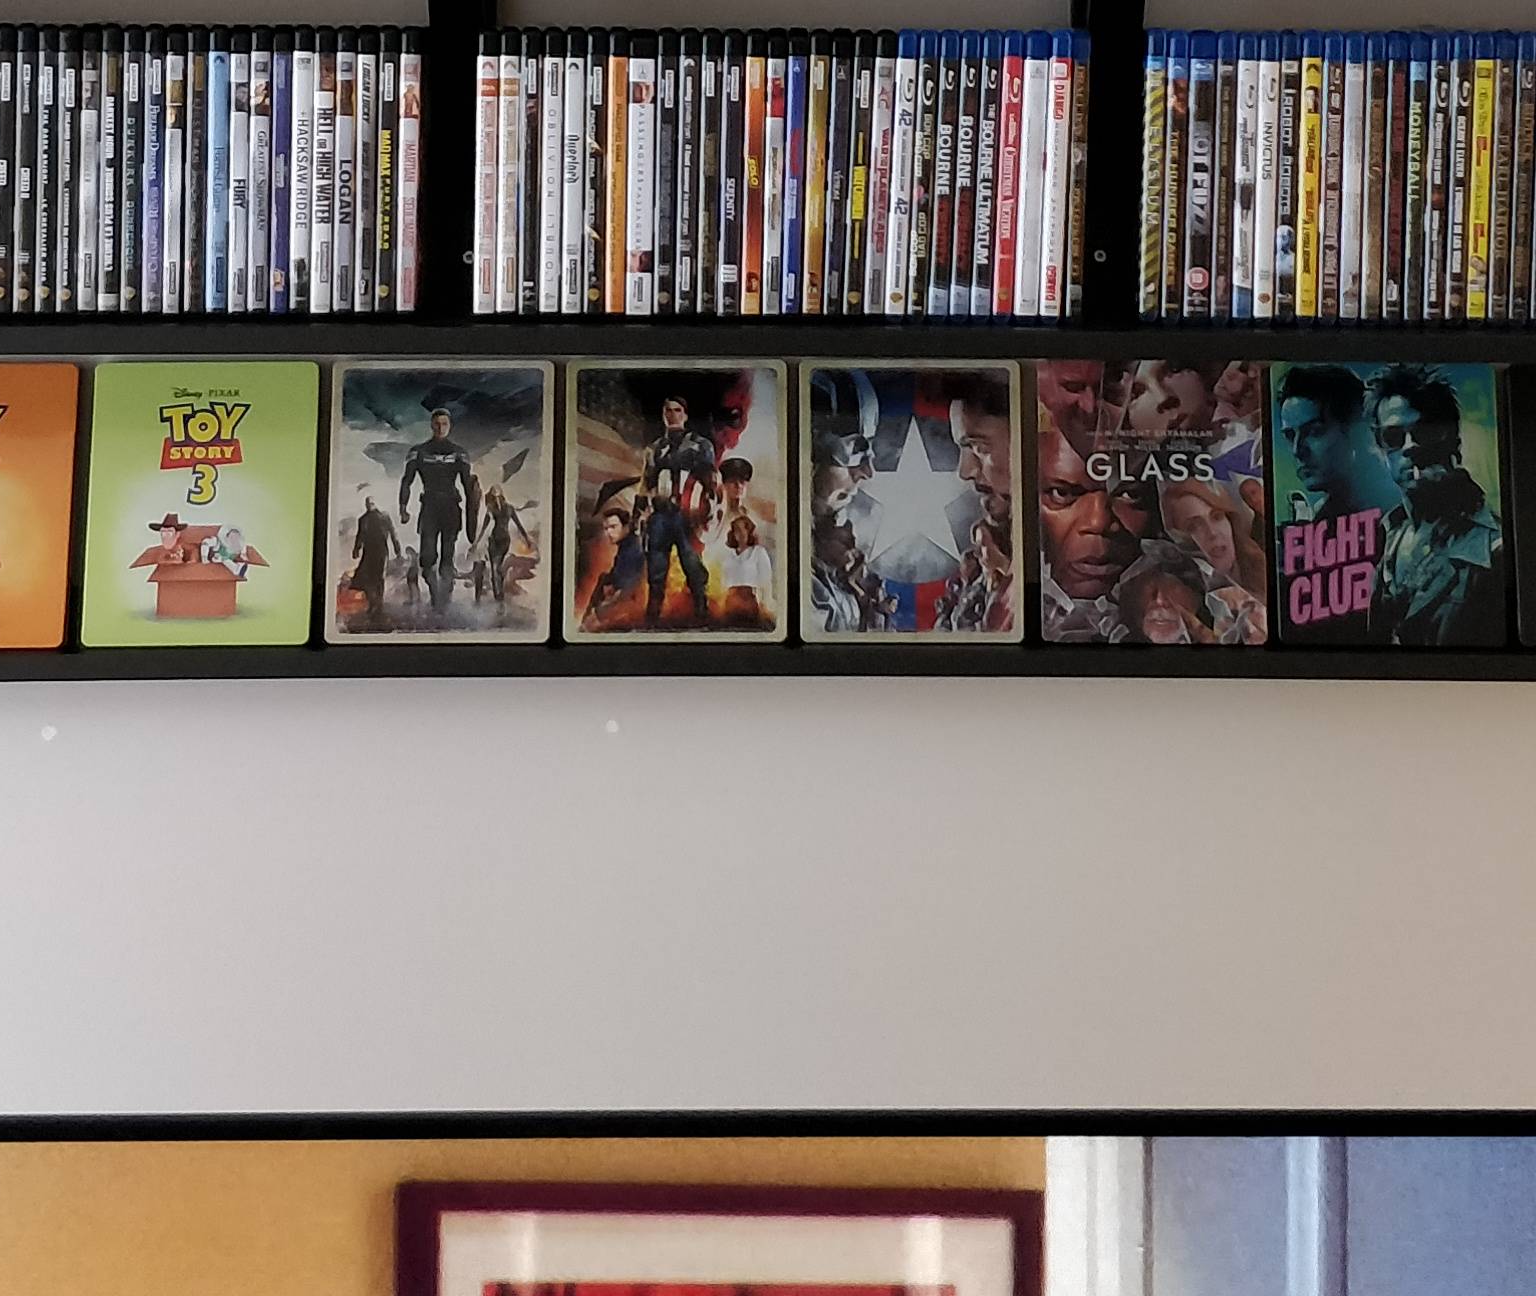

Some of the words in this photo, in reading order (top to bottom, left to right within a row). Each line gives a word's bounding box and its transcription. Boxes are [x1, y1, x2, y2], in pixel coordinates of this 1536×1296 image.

[362, 61, 371, 93] LOGAN
[315, 107, 333, 136] HELL
[899, 108, 912, 127] 42
[1053, 84, 1065, 121] DJANGO
[126, 117, 136, 187] DUNKIRK
[296, 118, 307, 185] HACKSAW
[380, 129, 392, 154] MAD
[546, 108, 556, 198] OBLIVION
[937, 124, 953, 196] BOURNE
[958, 115, 973, 188] BOURNE
[980, 119, 996, 178] BOURNE
[1261, 121, 1273, 181] INVICTUS
[1408, 101, 1423, 204] MONEYBALL
[315, 151, 332, 181] HIGH
[379, 153, 392, 176] MAX
[747, 158, 759, 187] SOLO
[1147, 125, 1159, 226] ELYSIUM
[232, 178, 246, 209] FURY
[295, 187, 307, 230] RIDGE
[315, 183, 332, 225] WATER
[338, 159, 352, 225] LOGAN
[724, 177, 736, 222] SERENITY
[894, 197, 908, 216] 42
[976, 181, 992, 265] ULTIMATUM
[209, 389, 240, 397] PIXAR
[160, 402, 250, 444] TOY
[169, 446, 235, 461] STORY
[1086, 453, 1215, 482] GLASS
[187, 464, 218, 505] 3
[1283, 507, 1382, 575] FIGHT
[1289, 563, 1377, 624] CLUB
